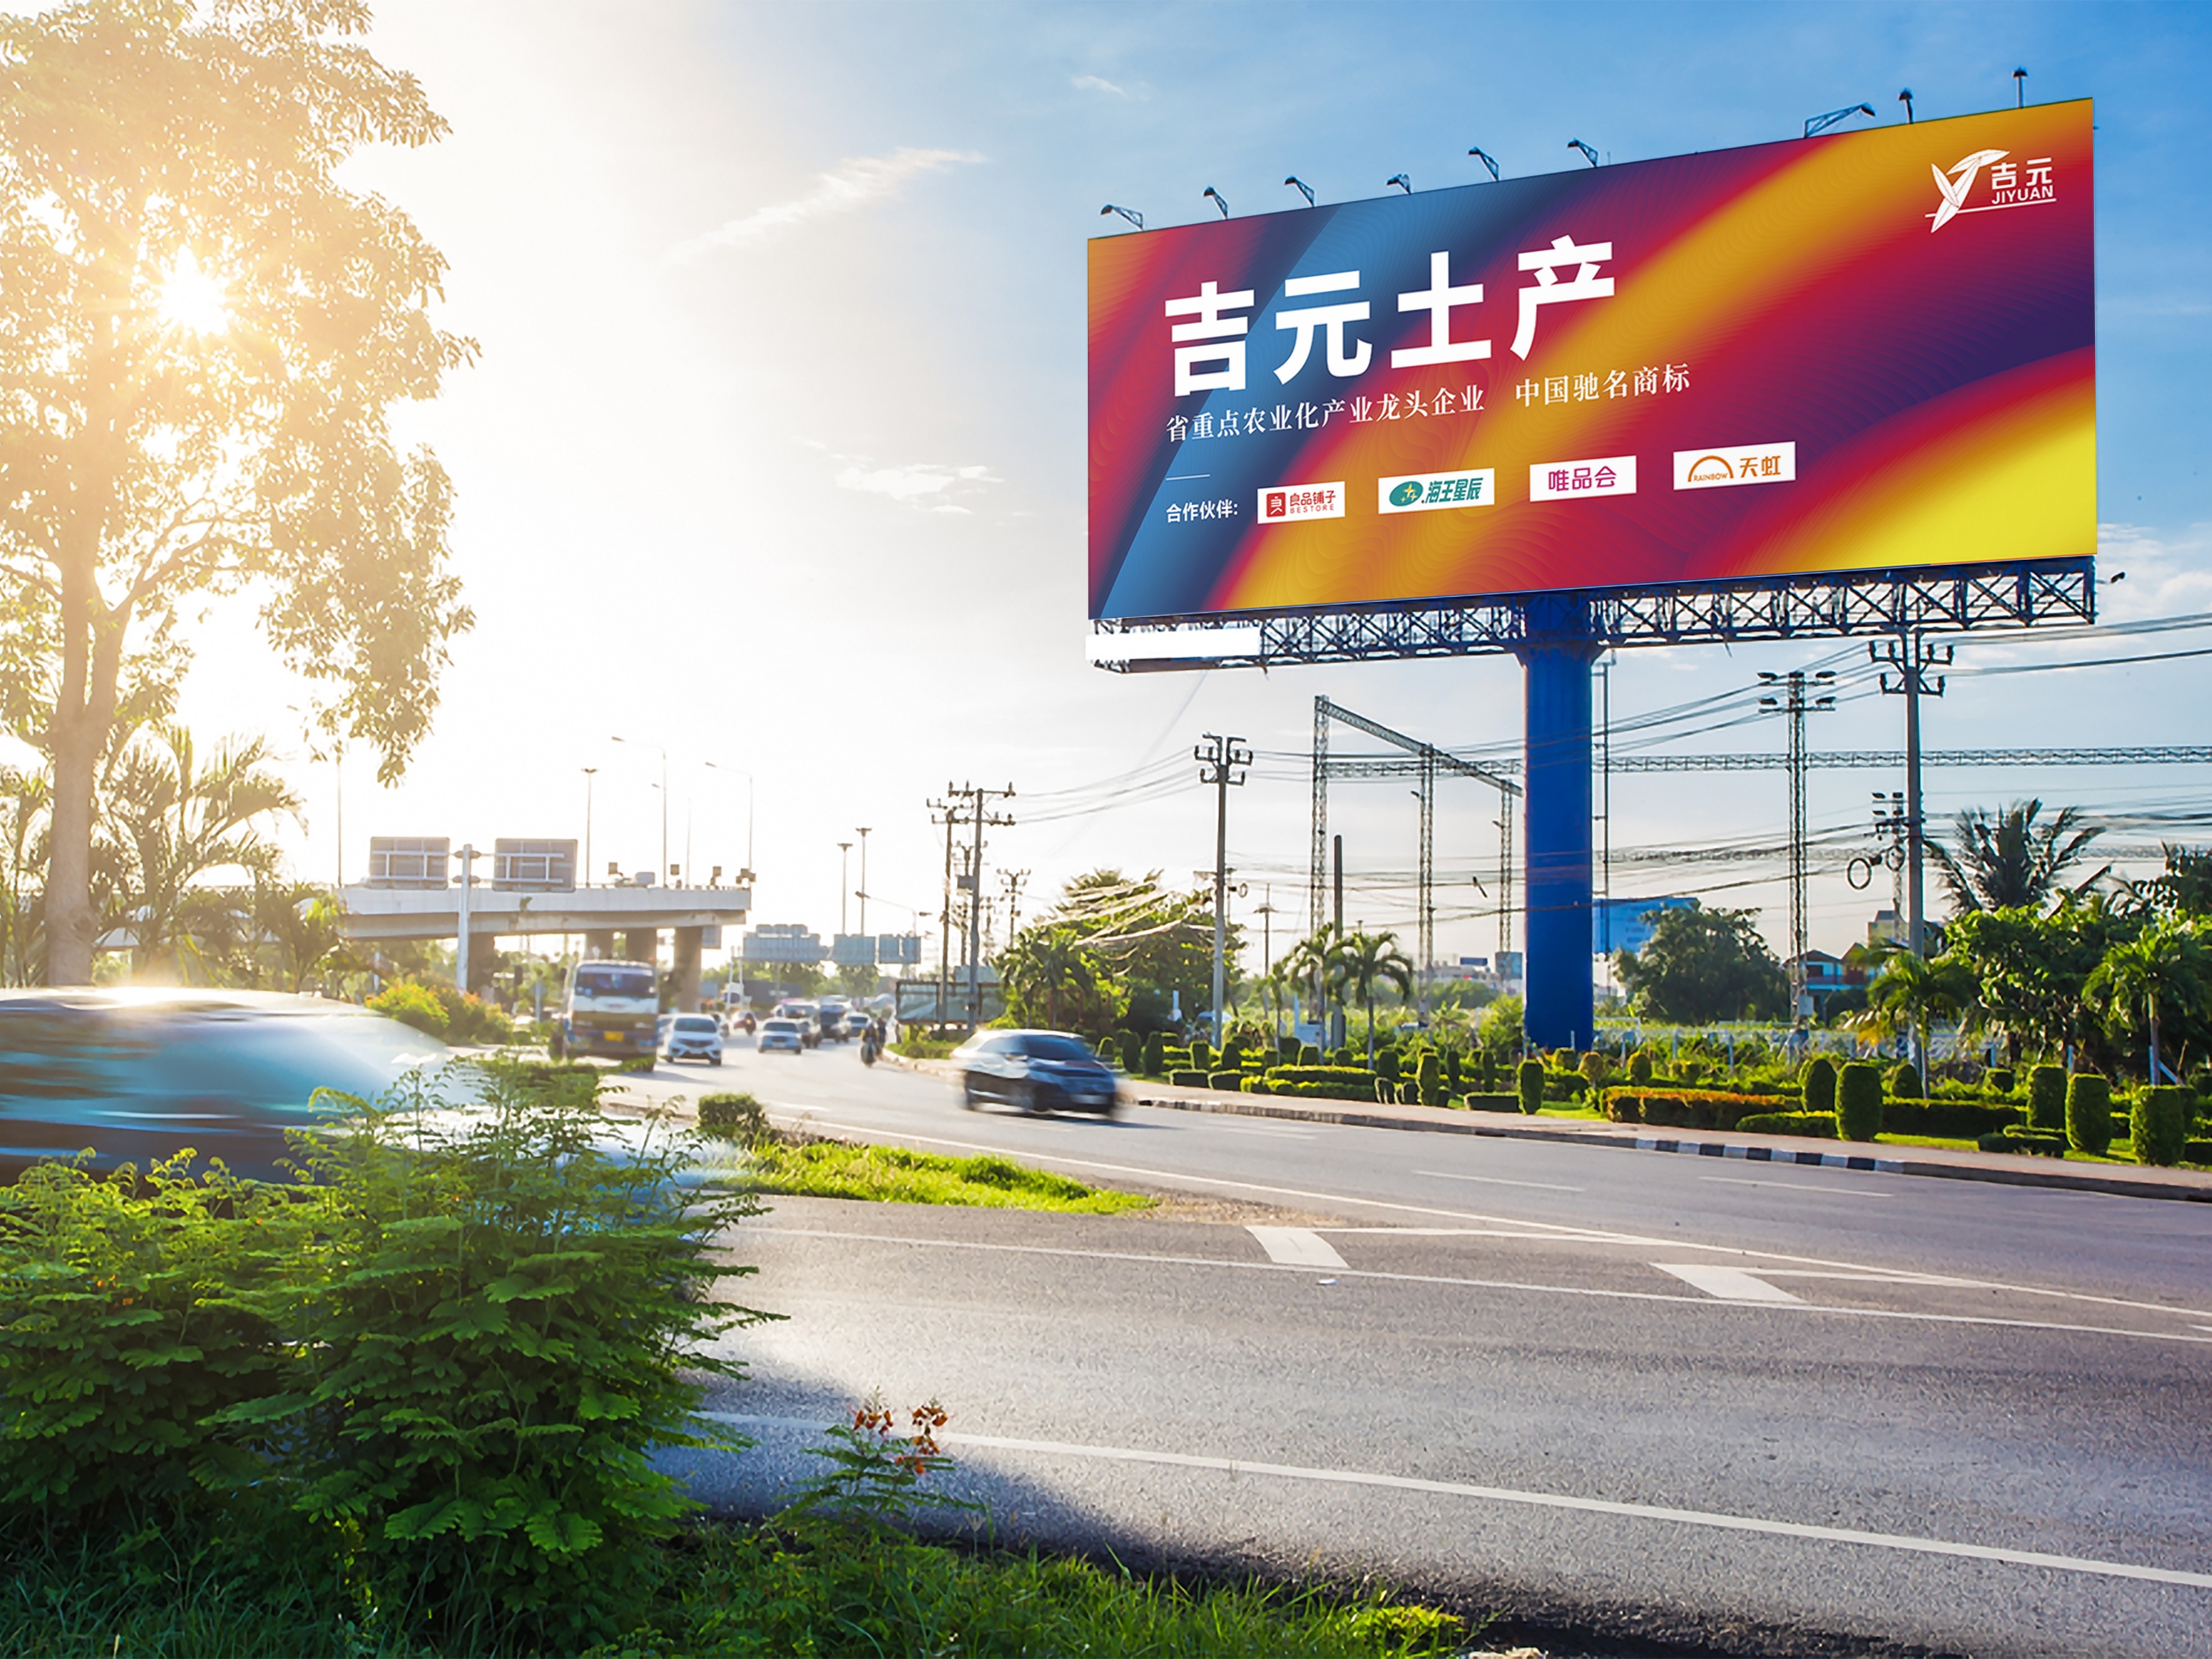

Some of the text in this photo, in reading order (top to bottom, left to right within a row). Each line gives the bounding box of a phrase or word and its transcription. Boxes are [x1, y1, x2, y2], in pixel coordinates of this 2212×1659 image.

[1991, 157, 2053, 190] 吉元
[1991, 185, 2054, 204] JIYUAN
[1165, 235, 1615, 397] 吉元土产
[1165, 363, 1690, 442] 省重点农业化产业龙头企业 中国驰名商标
[1548, 465, 1617, 492] 唯品会
[1693, 472, 1728, 482] RAINBOW
[1739, 455, 1782, 478] 天虹
[1290, 490, 1336, 507] 良品铺子
[1424, 477, 1484, 504] 海王星辰
[1290, 503, 1334, 514] BESTORE
